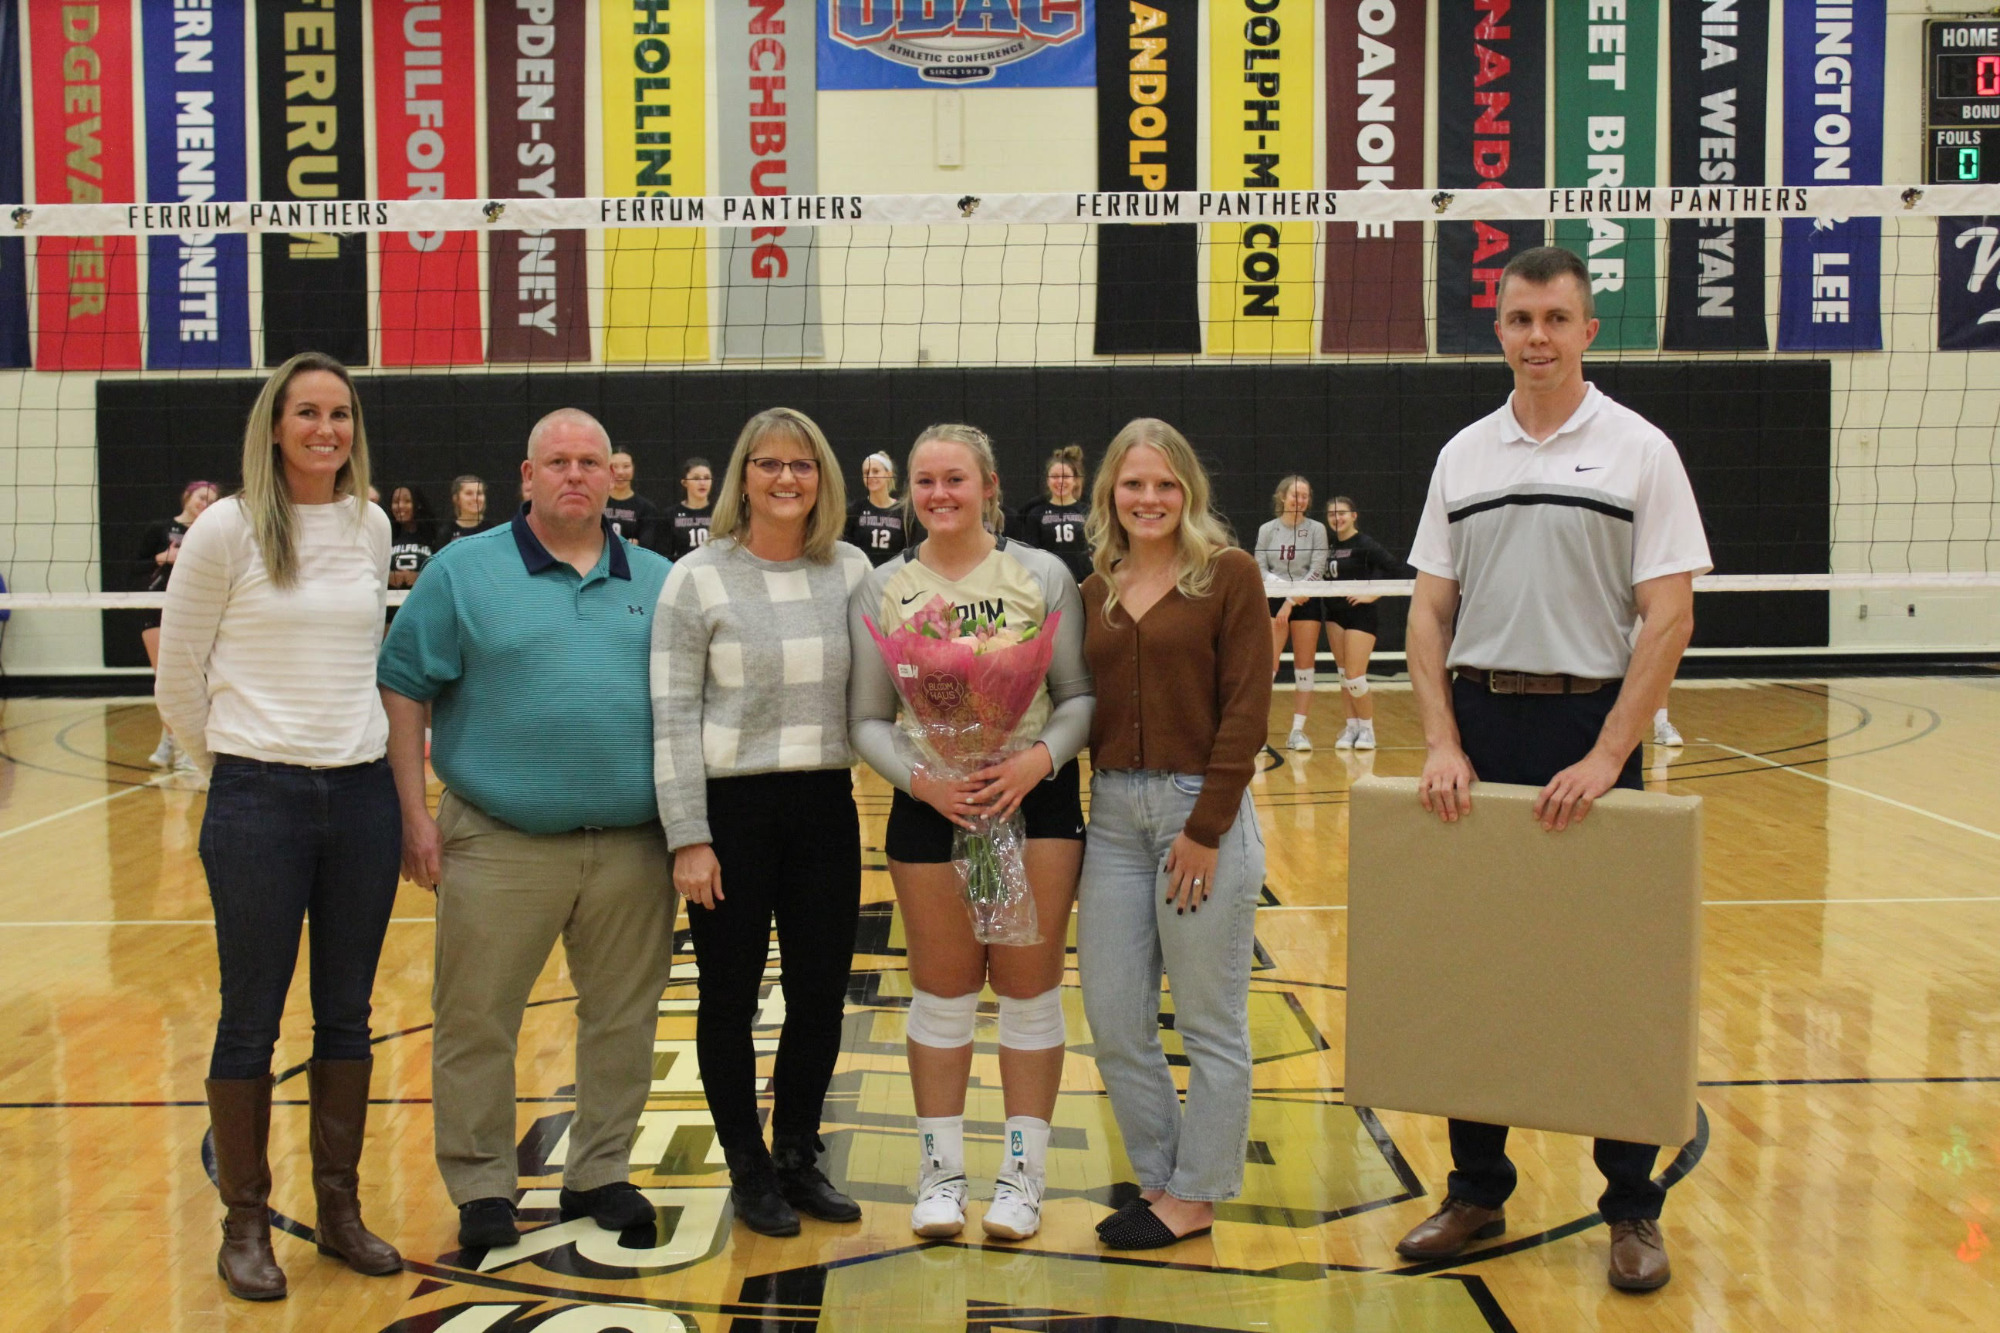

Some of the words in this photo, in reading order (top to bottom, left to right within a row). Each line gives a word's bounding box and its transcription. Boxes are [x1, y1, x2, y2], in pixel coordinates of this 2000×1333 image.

[1942, 28, 1998, 47] HOME
[888, 43, 942, 63] ATHLETIC
[947, 42, 1025, 63] CONFERENCE
[1813, 0, 1853, 180] INGTON
[1977, 56, 2000, 96] 0
[633, 0, 672, 198] HOLLIN
[1128, 0, 1168, 226] ANDOLP
[404, 0, 446, 252] UILFORD
[1937, 131, 1981, 145] FOULS
[61, 0, 105, 320] DGEWAER
[516, 0, 558, 336] PDEN-SYNEY
[1243, 0, 1281, 317] OLPH-MCON
[1471, 0, 1511, 309] NANDAH
[1959, 148, 1978, 180] 0
[601, 198, 704, 222] FERRUM
[724, 196, 863, 221] PANTHERS
[1076, 192, 1179, 217] FERRUM
[1200, 191, 1337, 216] PANTHERS
[1549, 189, 1651, 213] FERRUM
[1670, 188, 1808, 212] PANTHERS
[1587, 116, 1626, 295] BRAR
[1697, 88, 1737, 318] WESYAN
[128, 203, 231, 229] FERRUM
[250, 202, 389, 227] PANTHERS
[1812, 252, 1850, 323] LEE
[689, 528, 710, 547] 10
[871, 529, 891, 549] 12
[1055, 524, 1074, 543] 16
[1280, 545, 1296, 560] 18
[928, 682, 954, 691] BLOOM
[930, 691, 956, 700] HAUS
